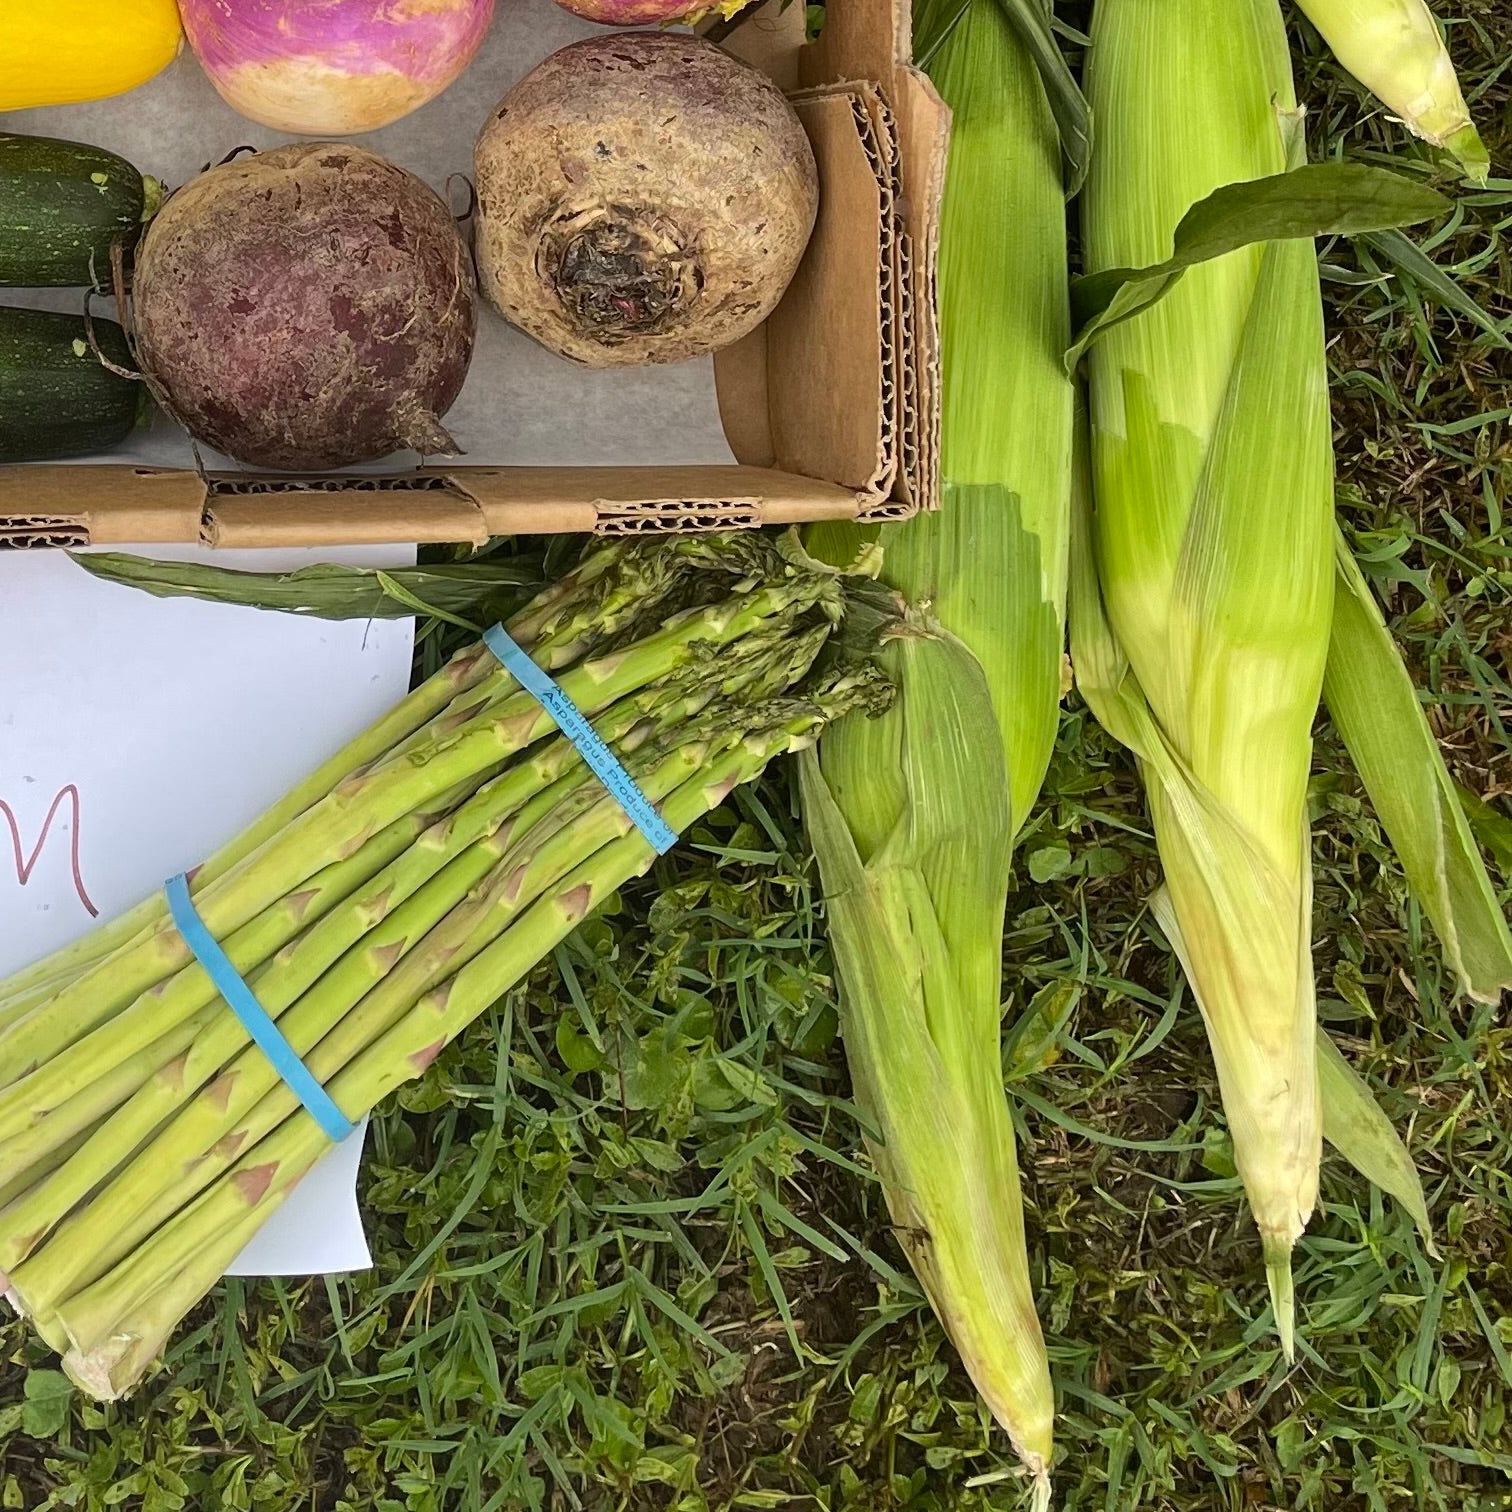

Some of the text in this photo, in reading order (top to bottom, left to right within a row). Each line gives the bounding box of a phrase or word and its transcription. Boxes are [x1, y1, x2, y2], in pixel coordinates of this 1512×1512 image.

[542, 690, 605, 767] Asparagus
[606, 769, 654, 828] Produce
[654, 830, 667, 843] of
